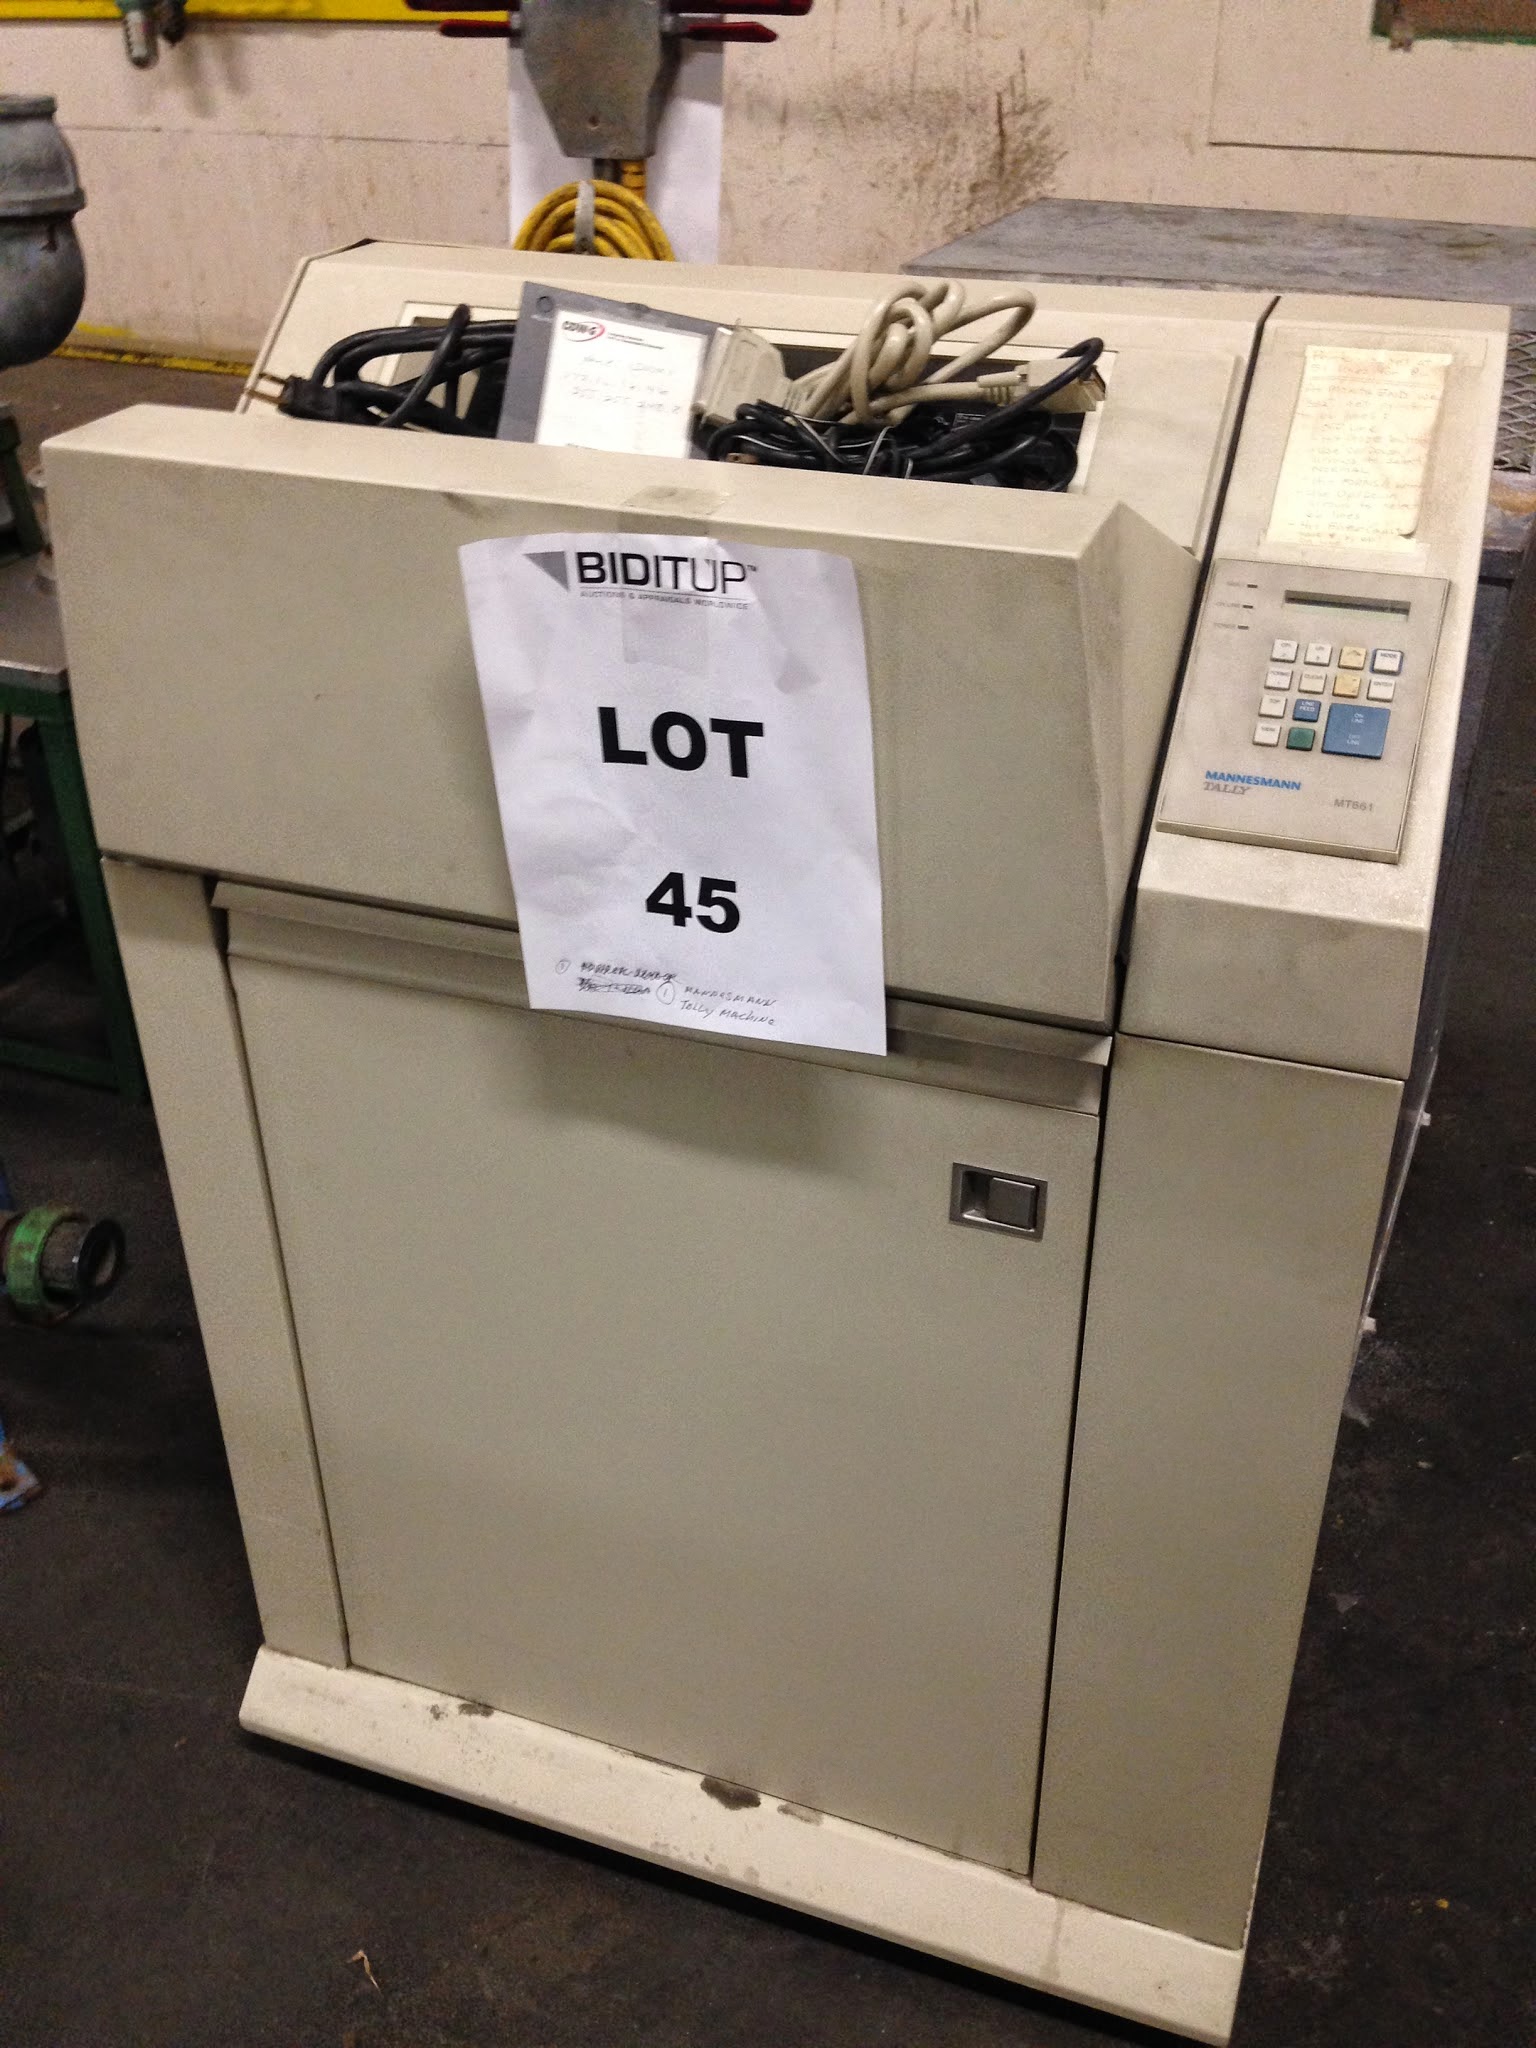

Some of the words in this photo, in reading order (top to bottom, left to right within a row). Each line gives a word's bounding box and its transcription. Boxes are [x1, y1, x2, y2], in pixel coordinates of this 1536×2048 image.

[597, 706, 764, 778] LOT
[1203, 781, 1250, 795] TALLY
[1205, 770, 1302, 791] MANNESMANN
[645, 872, 740, 933] 45
